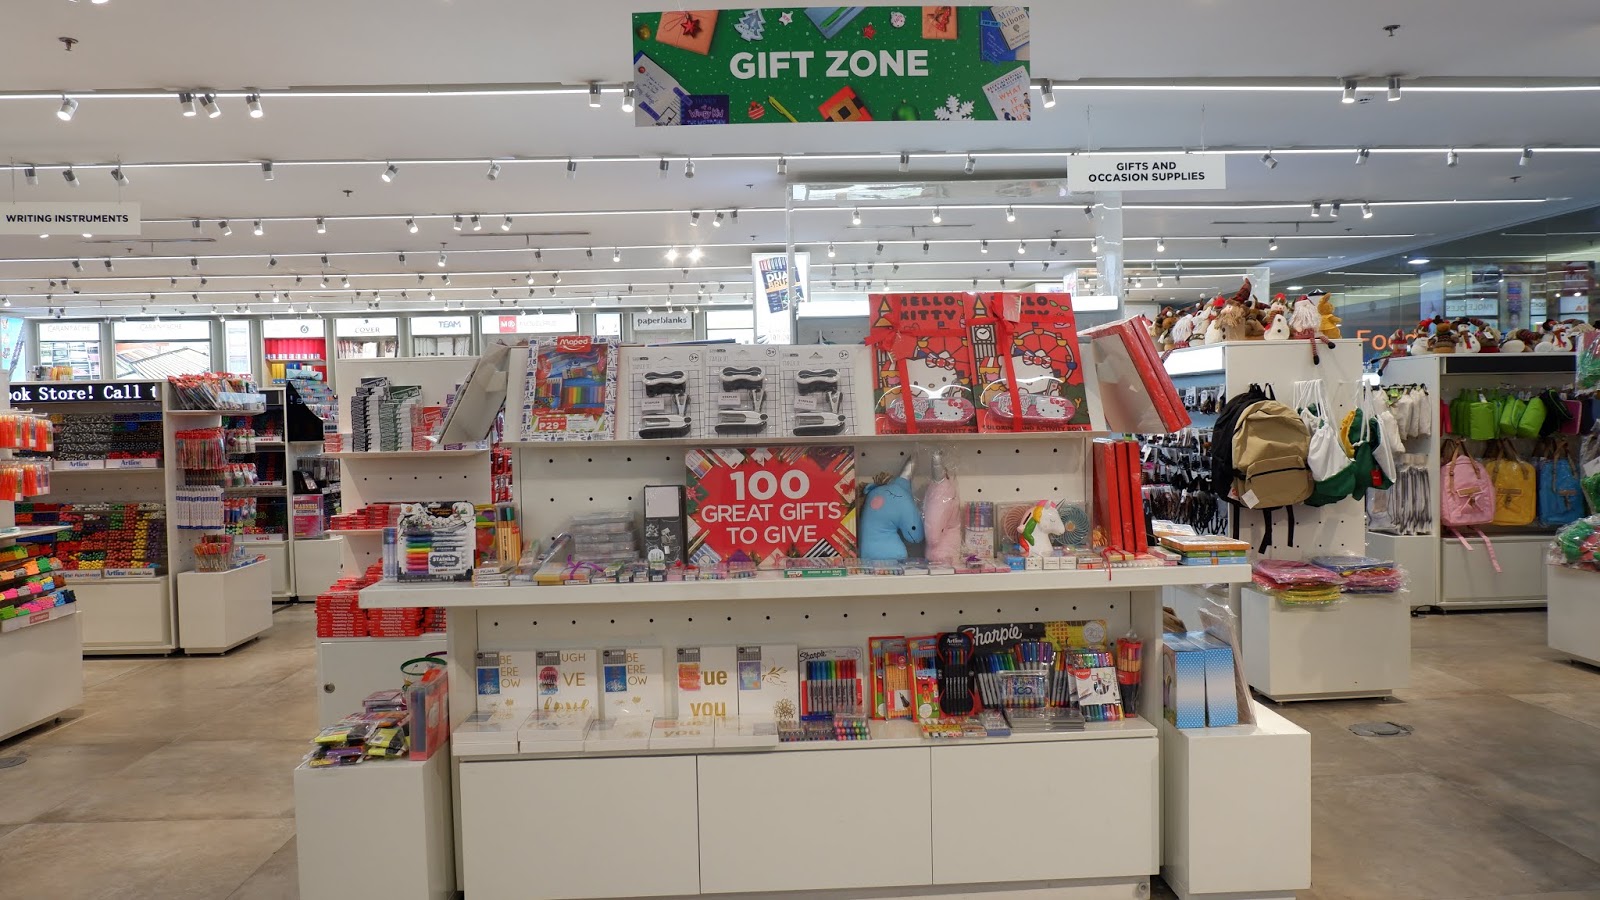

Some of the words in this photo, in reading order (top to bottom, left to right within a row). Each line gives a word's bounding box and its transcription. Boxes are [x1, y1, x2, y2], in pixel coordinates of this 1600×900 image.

[729, 52, 815, 79] GIFT
[825, 50, 929, 77] ZONE
[999, 85, 1021, 100] WHAT
[1016, 111, 1027, 120] US
[1116, 162, 1149, 171] GIFTS
[1152, 161, 1177, 170] AND
[1088, 173, 1149, 183] OCCASION
[1152, 171, 1206, 181] SUPPLIES
[6, 214, 52, 223] WRITING
[55, 214, 129, 223] INSTRUMENTS
[766, 271, 788, 283] DUA
[900, 295, 956, 306] HELLO
[900, 310, 957, 321] KITTY
[438, 320, 462, 328] TEAM
[637, 316, 688, 326] paperblanks
[354, 326, 381, 334] COVER
[560, 338, 589, 346] Maped
[39, 385, 94, 401] Store!
[103, 384, 142, 400] Call
[120, 459, 142, 467] Artline
[729, 469, 811, 501] 100
[701, 503, 774, 523] GREAT
[779, 501, 842, 521] GIFTS
[726, 526, 758, 545] TO
[764, 524, 818, 544] GIVE
[106, 569, 126, 577] Artline
[962, 623, 1023, 647] Sharpie
[500, 655, 512, 665] BE
[561, 653, 586, 662] UGH
[626, 653, 639, 663] BE
[800, 650, 827, 662] Sharpie
[501, 667, 519, 676] ERE
[627, 665, 646, 674] ERE
[563, 672, 586, 687] VE
[628, 676, 648, 686] OW
[700, 670, 728, 685] ue
[501, 679, 521, 688] OW
